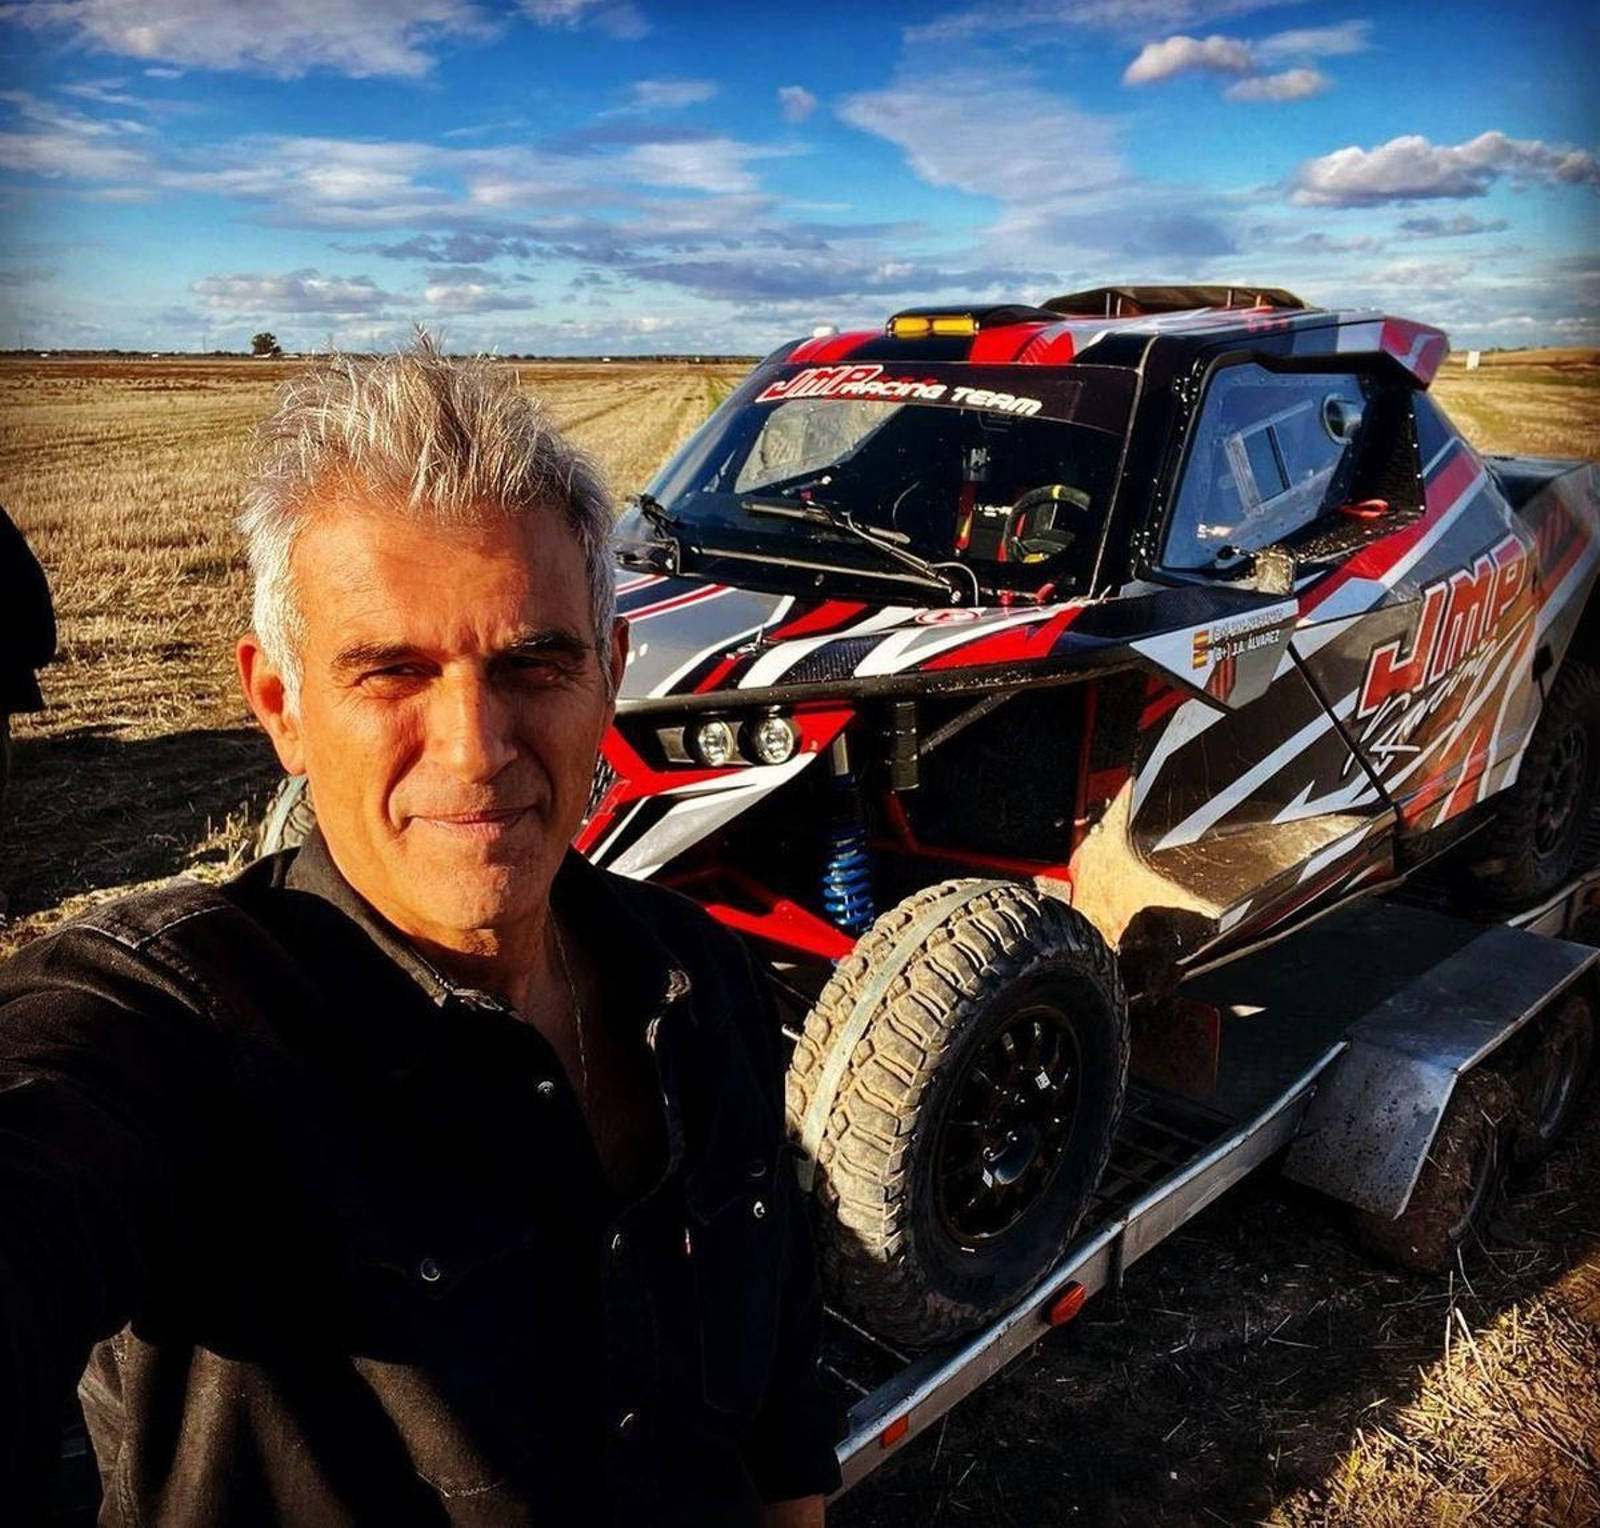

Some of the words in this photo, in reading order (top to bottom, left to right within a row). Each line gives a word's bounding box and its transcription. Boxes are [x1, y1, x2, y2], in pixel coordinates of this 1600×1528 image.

[754, 364, 884, 403] JMP
[840, 380, 948, 400] RACING
[951, 386, 1043, 416] TEAM
[1357, 534, 1527, 719] JMP
[1342, 632, 1502, 777] Racing
